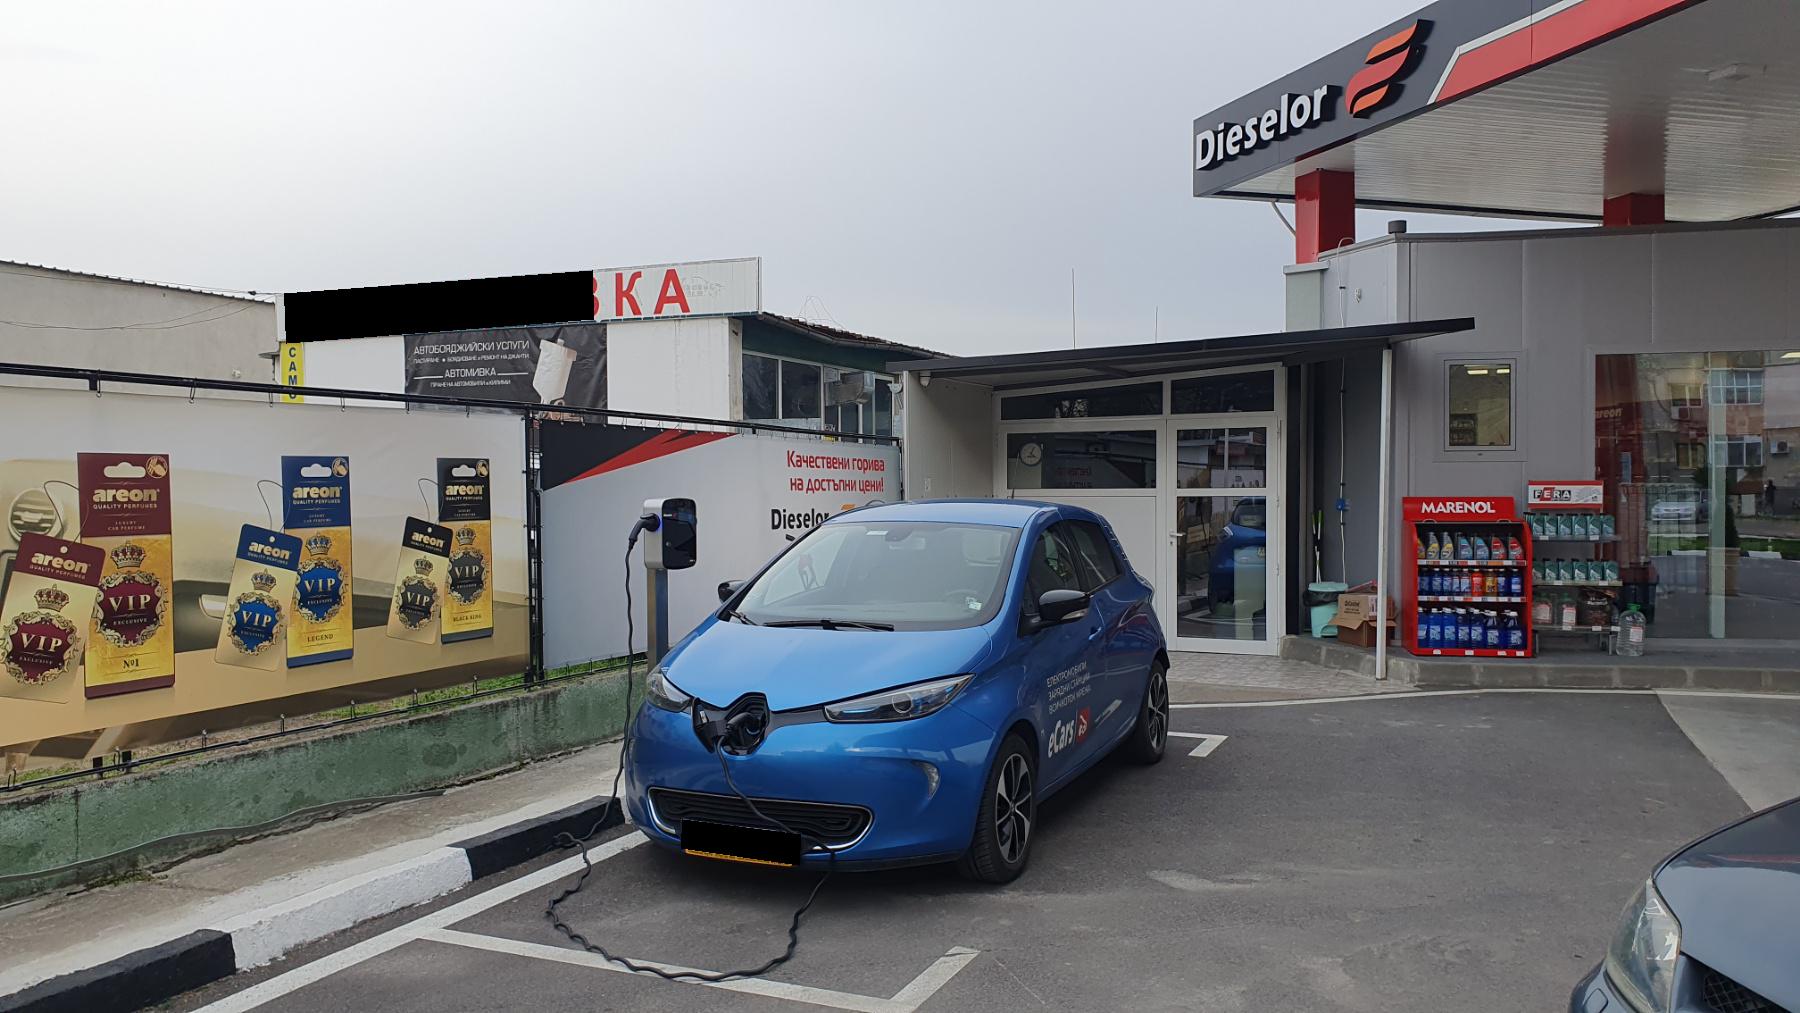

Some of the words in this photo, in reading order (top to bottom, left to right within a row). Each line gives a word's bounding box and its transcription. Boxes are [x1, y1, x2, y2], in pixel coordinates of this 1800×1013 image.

[1195, 84, 1329, 170] Dieselor
[414, 341, 494, 355] АВТОБОЯДЖИЙСКИ
[496, 340, 530, 351] УСЛУГИ
[444, 368, 496, 378] АВТОМИВКА
[786, 450, 850, 470] Качествени
[852, 457, 885, 473] горива
[292, 486, 340, 498] areon
[446, 485, 483, 496] areon
[790, 478, 803, 491] на
[806, 478, 856, 494] достъпни
[858, 477, 884, 494] цени!
[92, 488, 158, 502] areon
[1534, 489, 1571, 500] FERA
[1421, 501, 1495, 514] MARENOL
[771, 508, 829, 530] Dieselor
[412, 532, 444, 548] areon
[249, 542, 290, 560] areon
[31, 552, 88, 574] areon
[454, 566, 480, 579] VIP
[304, 577, 336, 593] VIP
[109, 594, 151, 611] VIP
[406, 591, 430, 606] VIP
[113, 618, 148, 626] EXCLUSIVE
[242, 610, 272, 628] VIP
[20, 633, 63, 652] VIP
[307, 633, 334, 643] LEGEND
[1048, 720, 1075, 758] eCars
